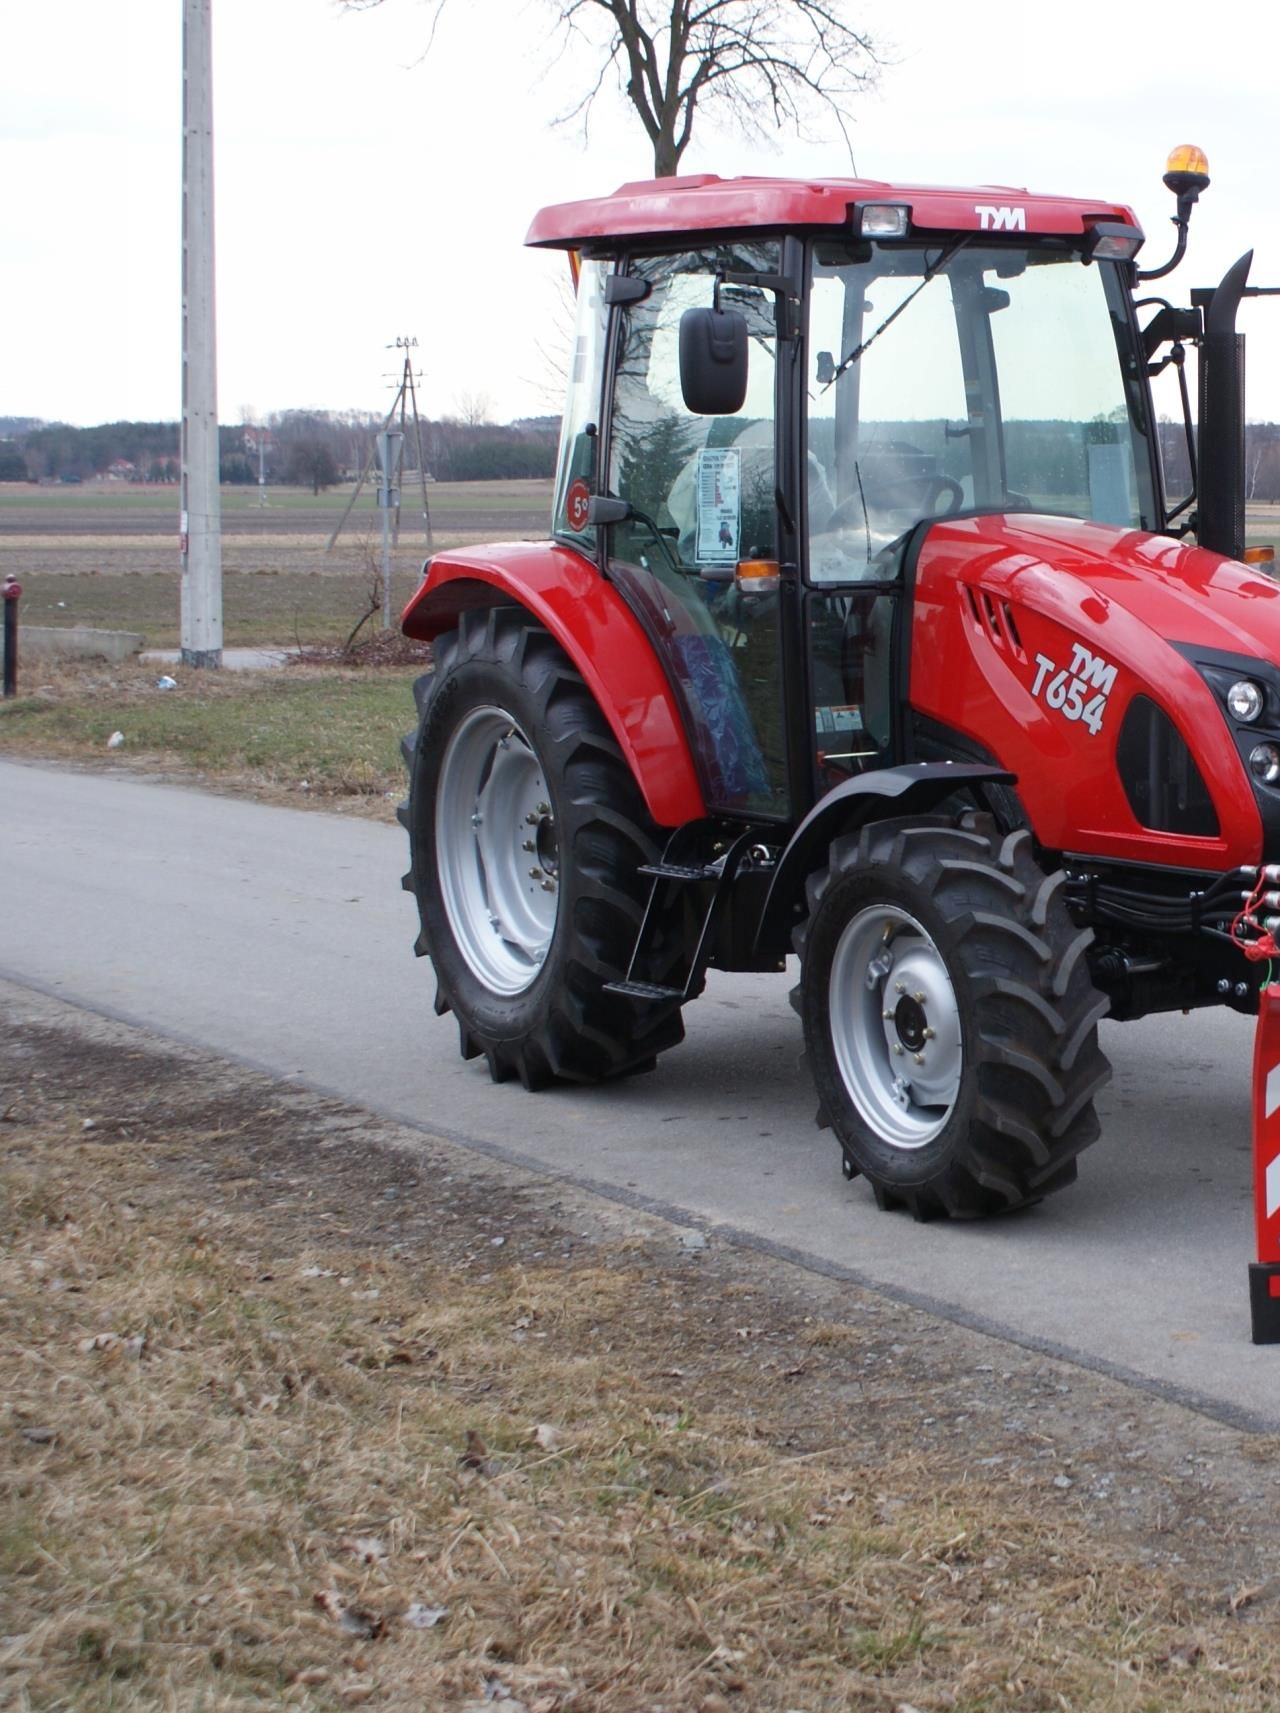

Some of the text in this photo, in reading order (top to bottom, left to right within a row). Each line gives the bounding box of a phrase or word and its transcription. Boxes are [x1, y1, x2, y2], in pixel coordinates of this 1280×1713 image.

[975, 205, 1026, 231] TYM
[1031, 652, 1107, 736] T654
[1070, 642, 1119, 697] TYM
